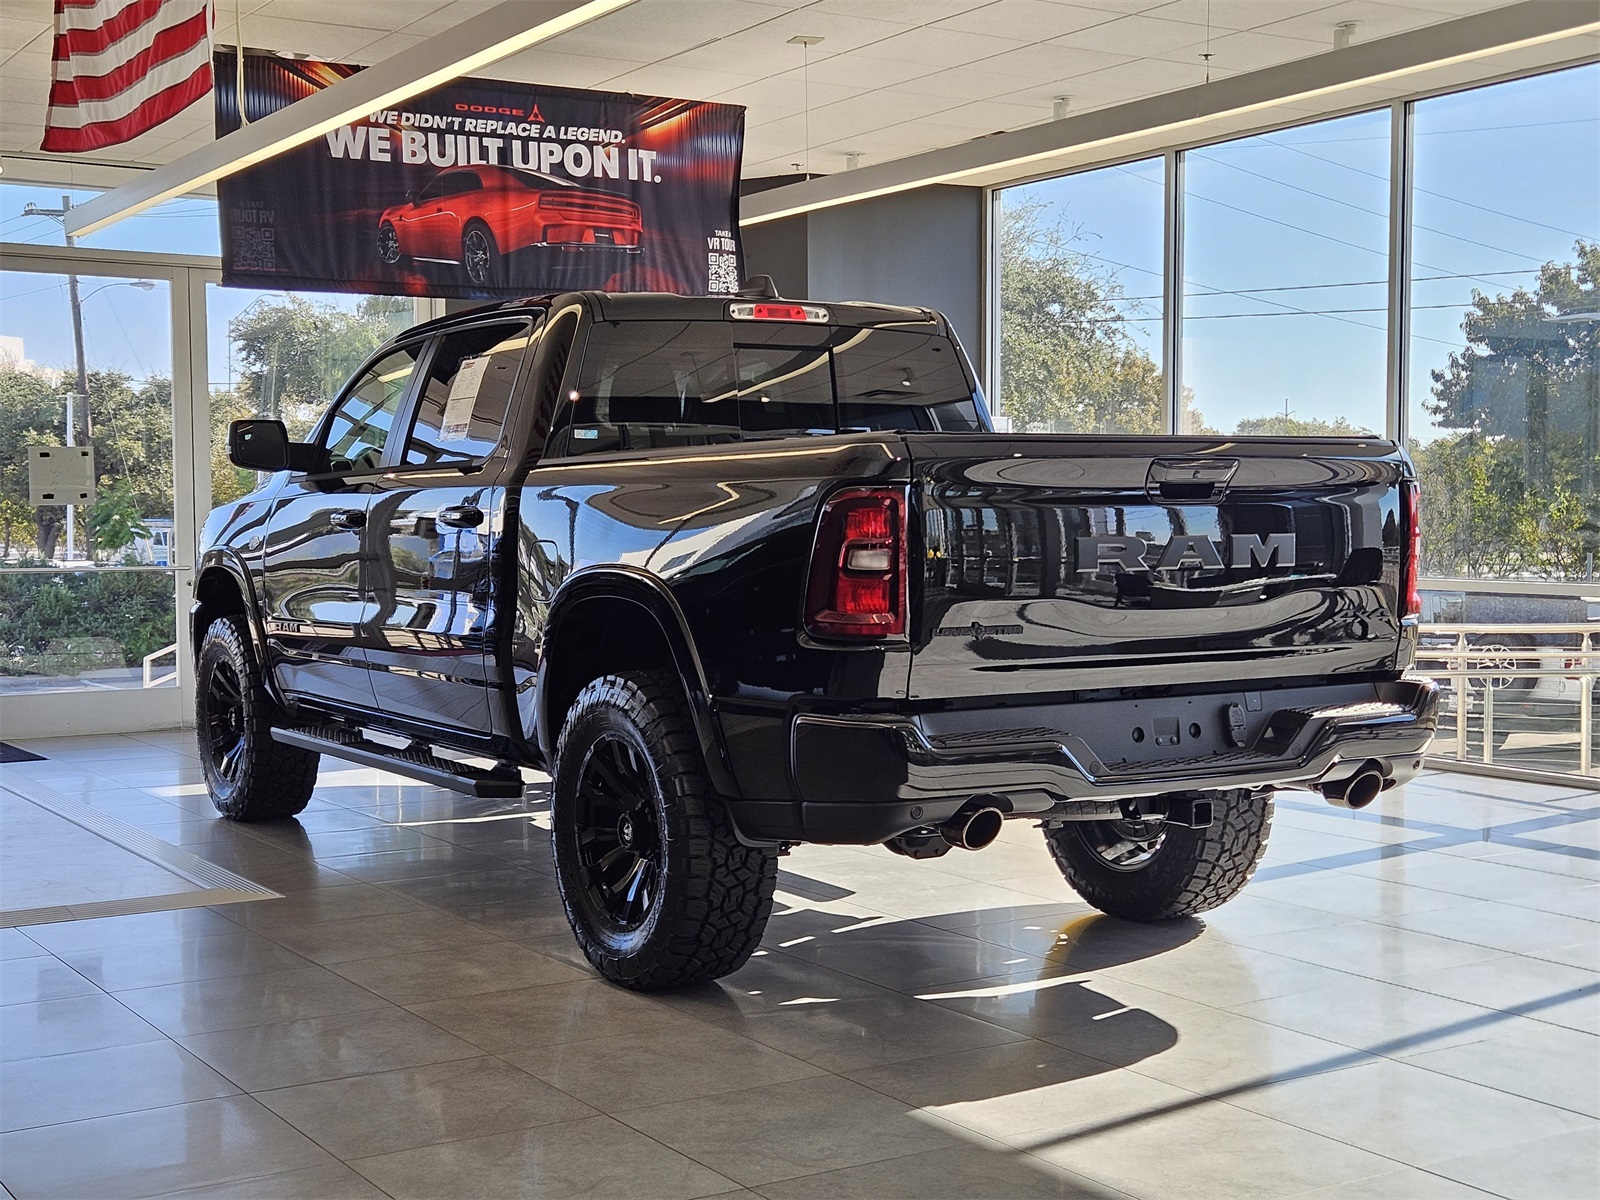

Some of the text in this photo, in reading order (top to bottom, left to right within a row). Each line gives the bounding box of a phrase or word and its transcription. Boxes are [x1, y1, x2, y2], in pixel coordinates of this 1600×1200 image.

[455, 103, 524, 116] DODGE
[369, 110, 626, 144] WE DIDN'T REPLACE A LEGEND.
[325, 125, 662, 184] WE BUILT UPON IT.
[707, 237, 720, 250] VR
[1074, 533, 1296, 573] RAM
[275, 622, 298, 632] RAM
